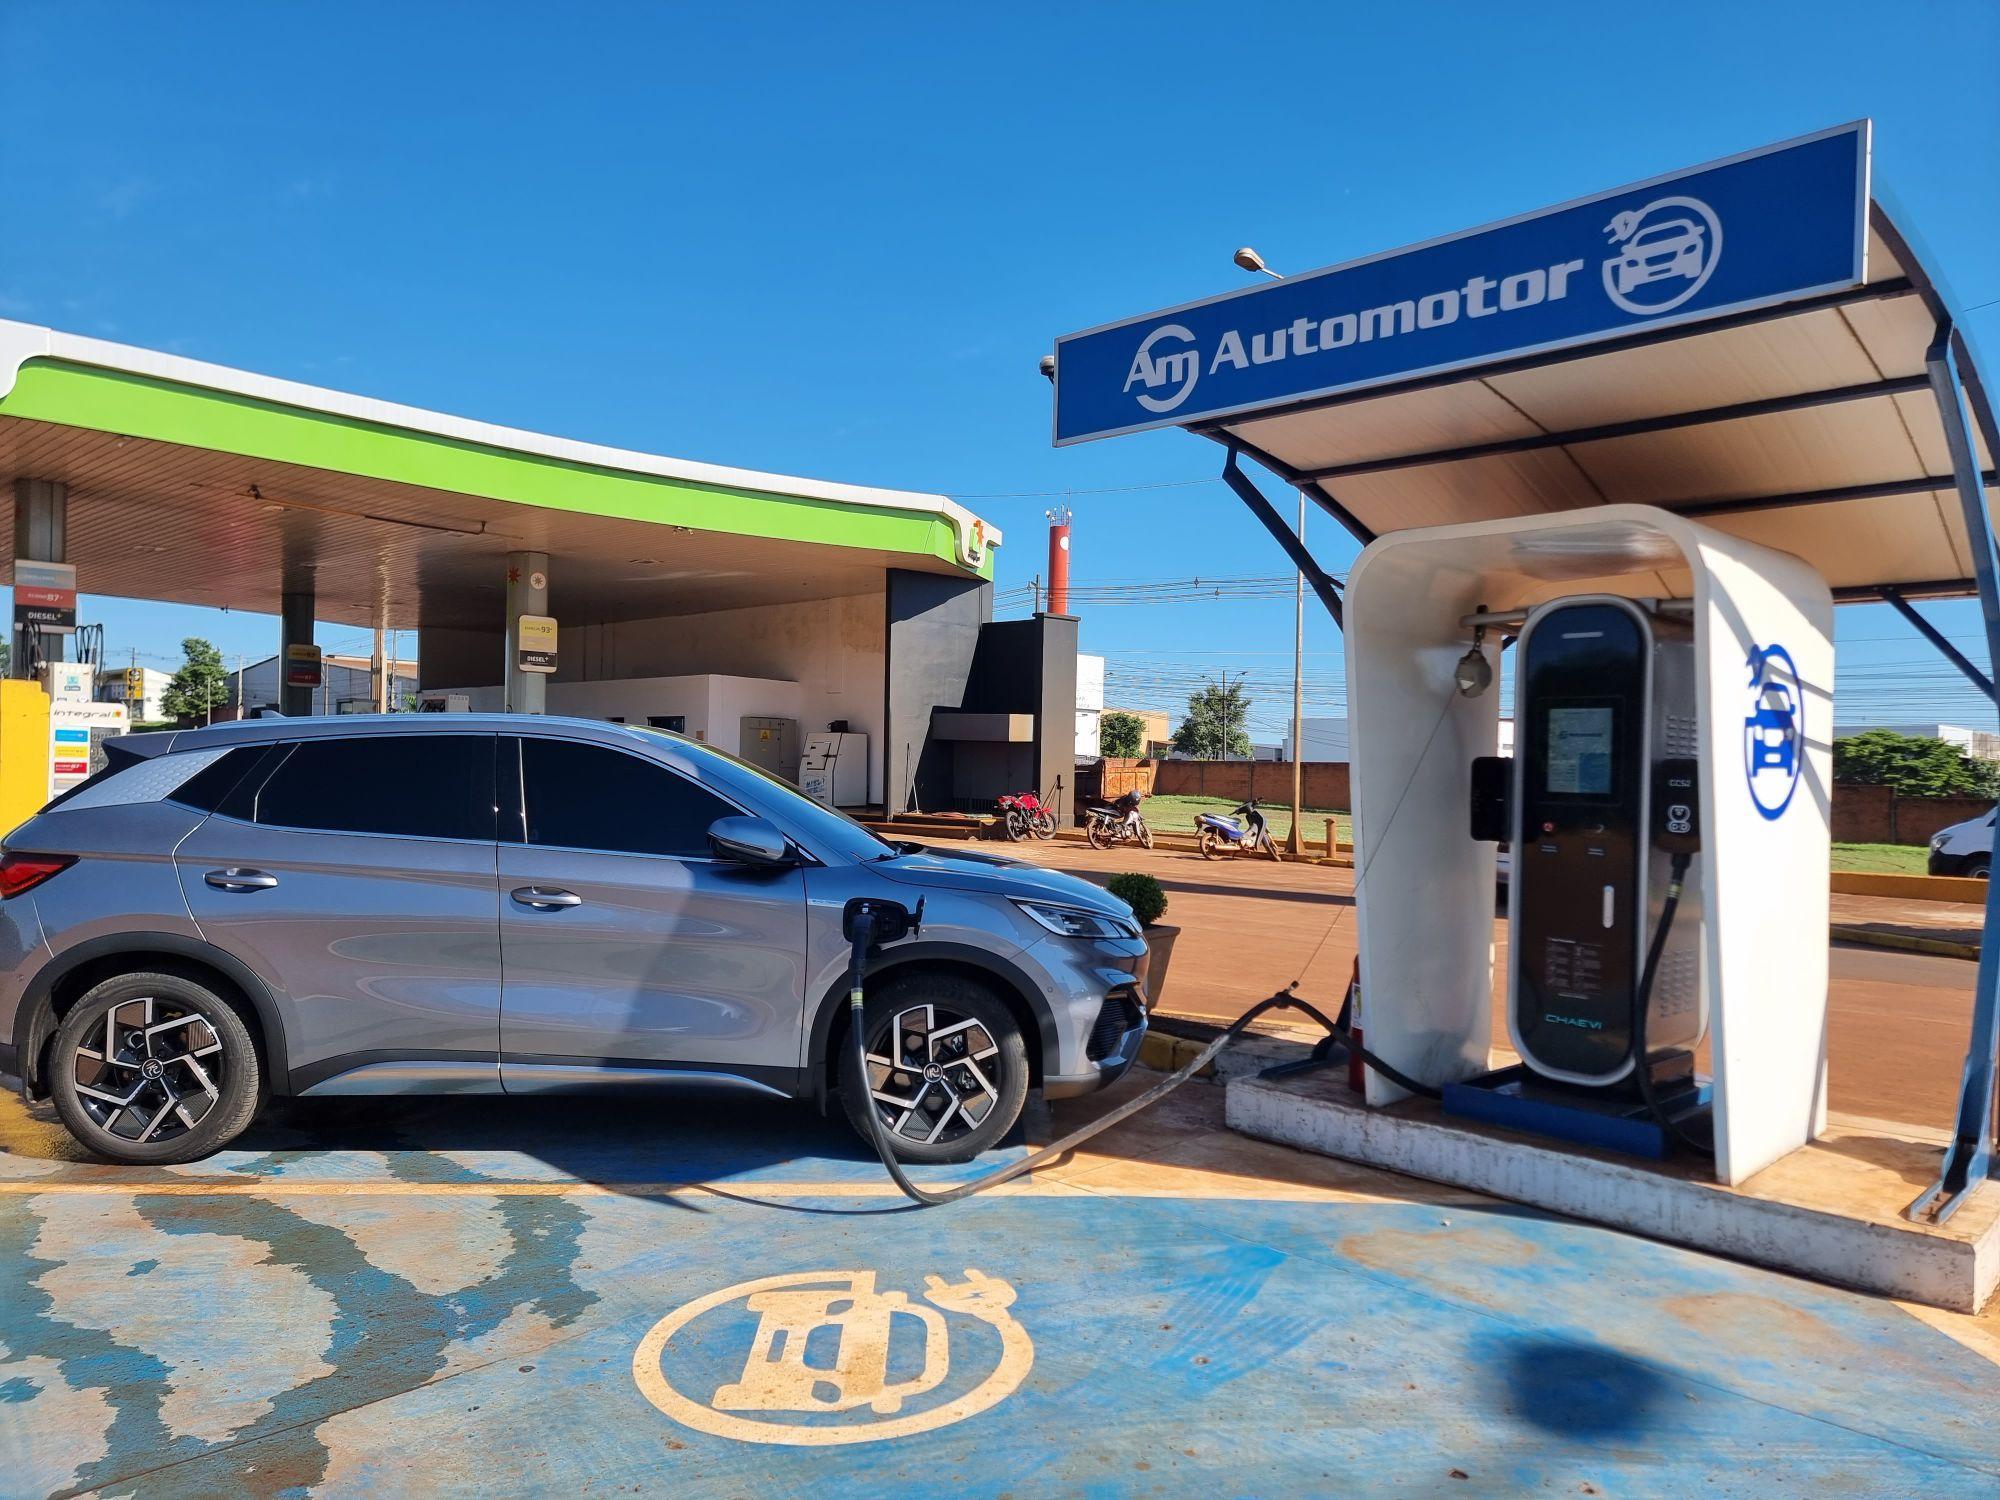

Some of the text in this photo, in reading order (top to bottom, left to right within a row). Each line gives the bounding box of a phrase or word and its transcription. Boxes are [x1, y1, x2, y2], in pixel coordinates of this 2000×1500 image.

[1208, 259, 1583, 376] Automotor
[54, 709, 111, 718] integral
[1545, 1014, 1602, 1030] CHAEVI
